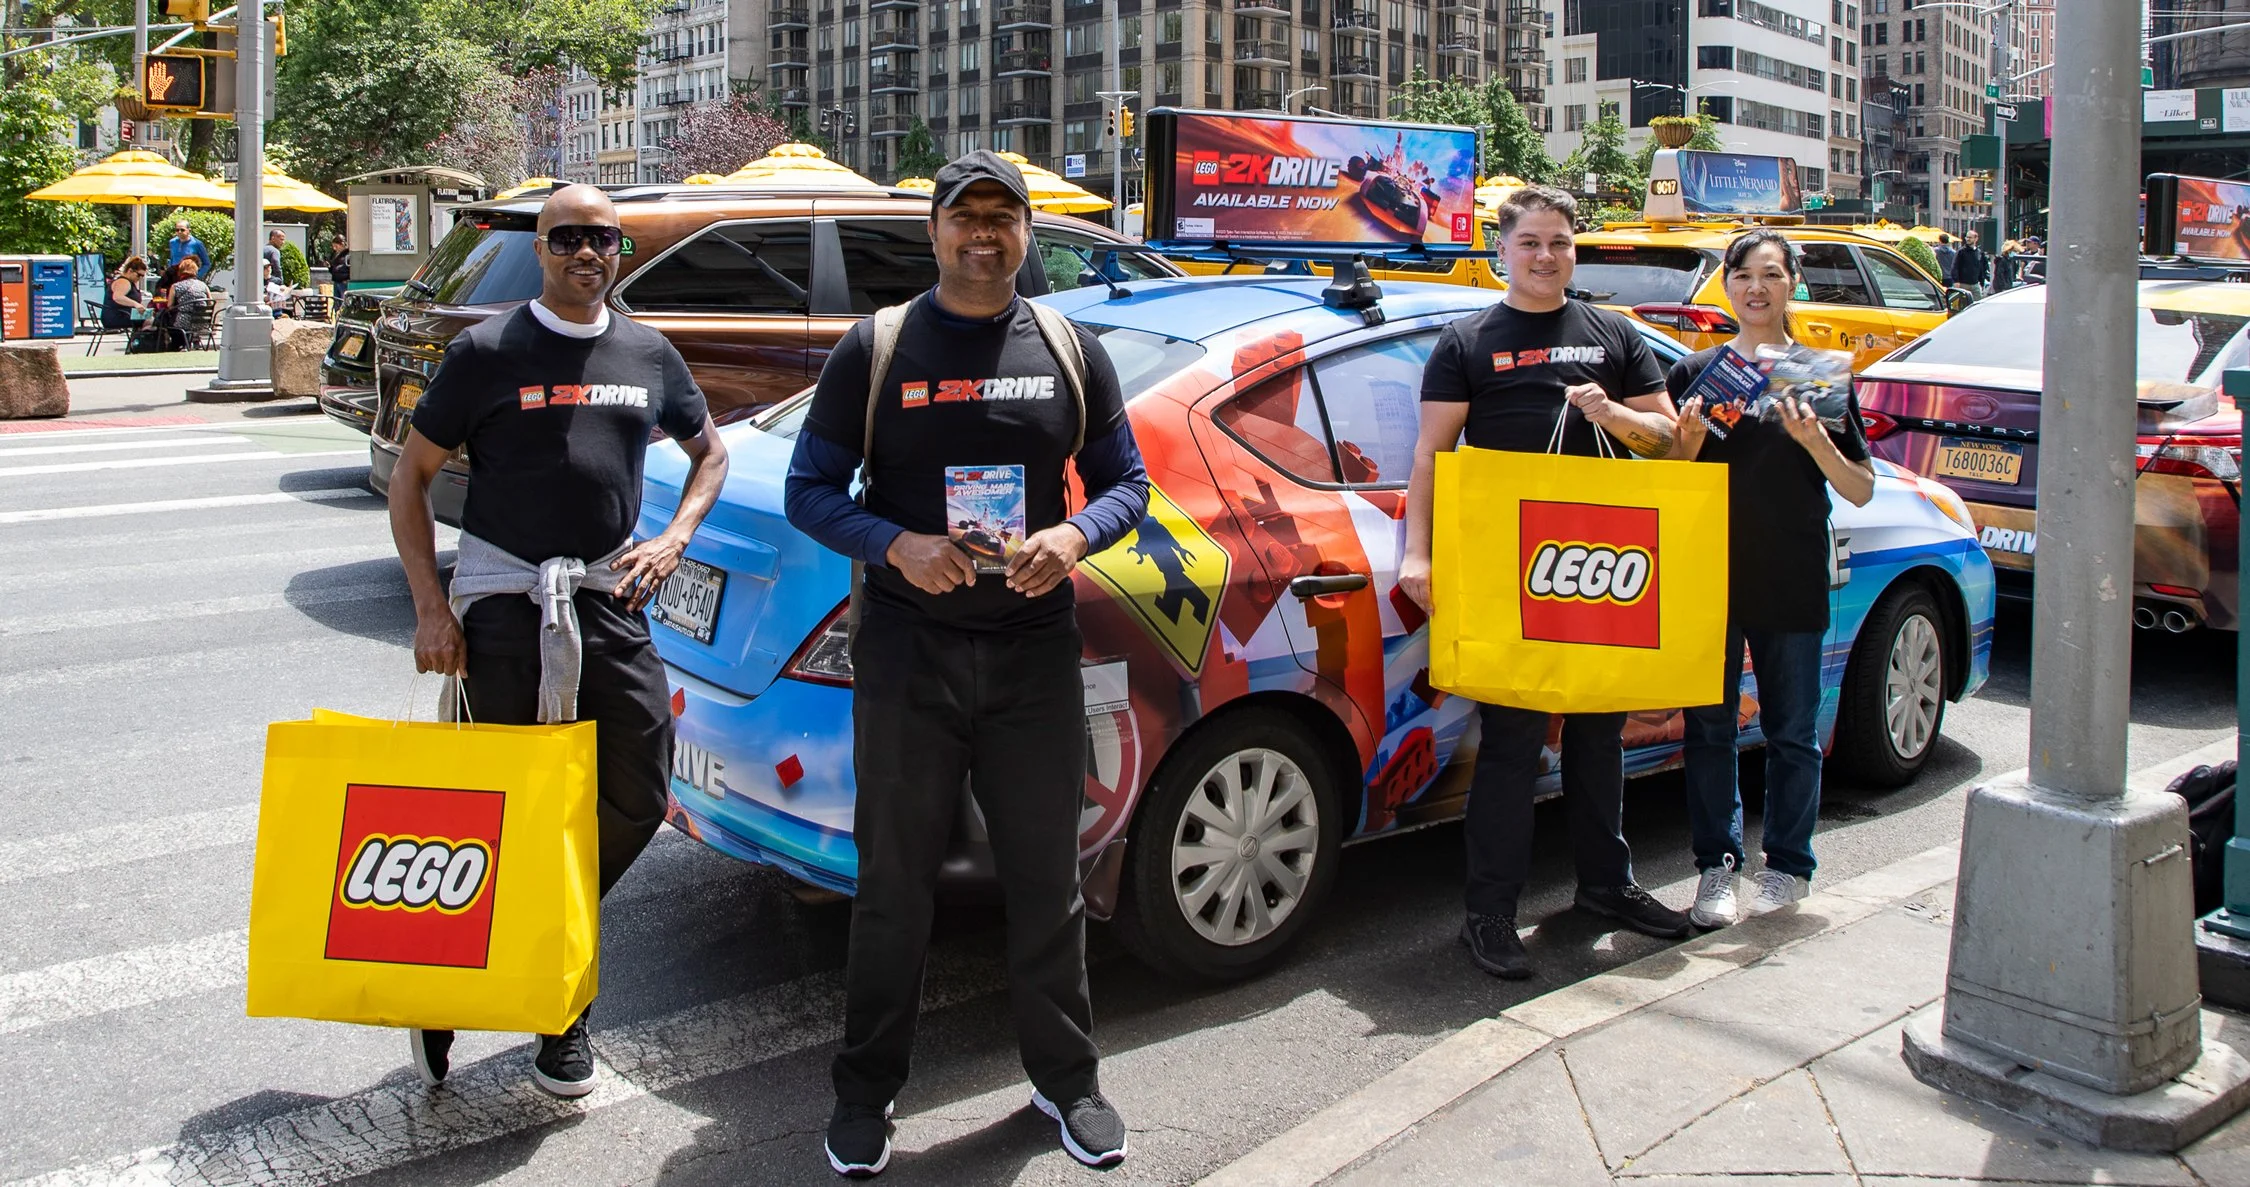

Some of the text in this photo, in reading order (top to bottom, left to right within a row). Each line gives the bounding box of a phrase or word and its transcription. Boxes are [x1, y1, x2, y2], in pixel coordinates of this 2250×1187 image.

[1195, 162, 1218, 174] LEGO
[1733, 158, 1747, 168] Disney
[1656, 181, 1676, 194] 9C17
[1710, 174, 1778, 194] LITTLE MERMAID
[1193, 193, 1339, 210] AVAILABLE NOW
[2182, 227, 2215, 236] AVAILABLE
[1922, 420, 2034, 436] CAMRY
[1981, 442, 2003, 451] YORK
[1946, 449, 2013, 474] T680036C
[1980, 526, 2036, 554] DRIV
[1528, 544, 1650, 602] LEGO
[686, 582, 714, 622] 8540
[1106, 702, 1128, 710] Interact
[673, 735, 726, 800] RIVE
[343, 838, 489, 910] LEGO
